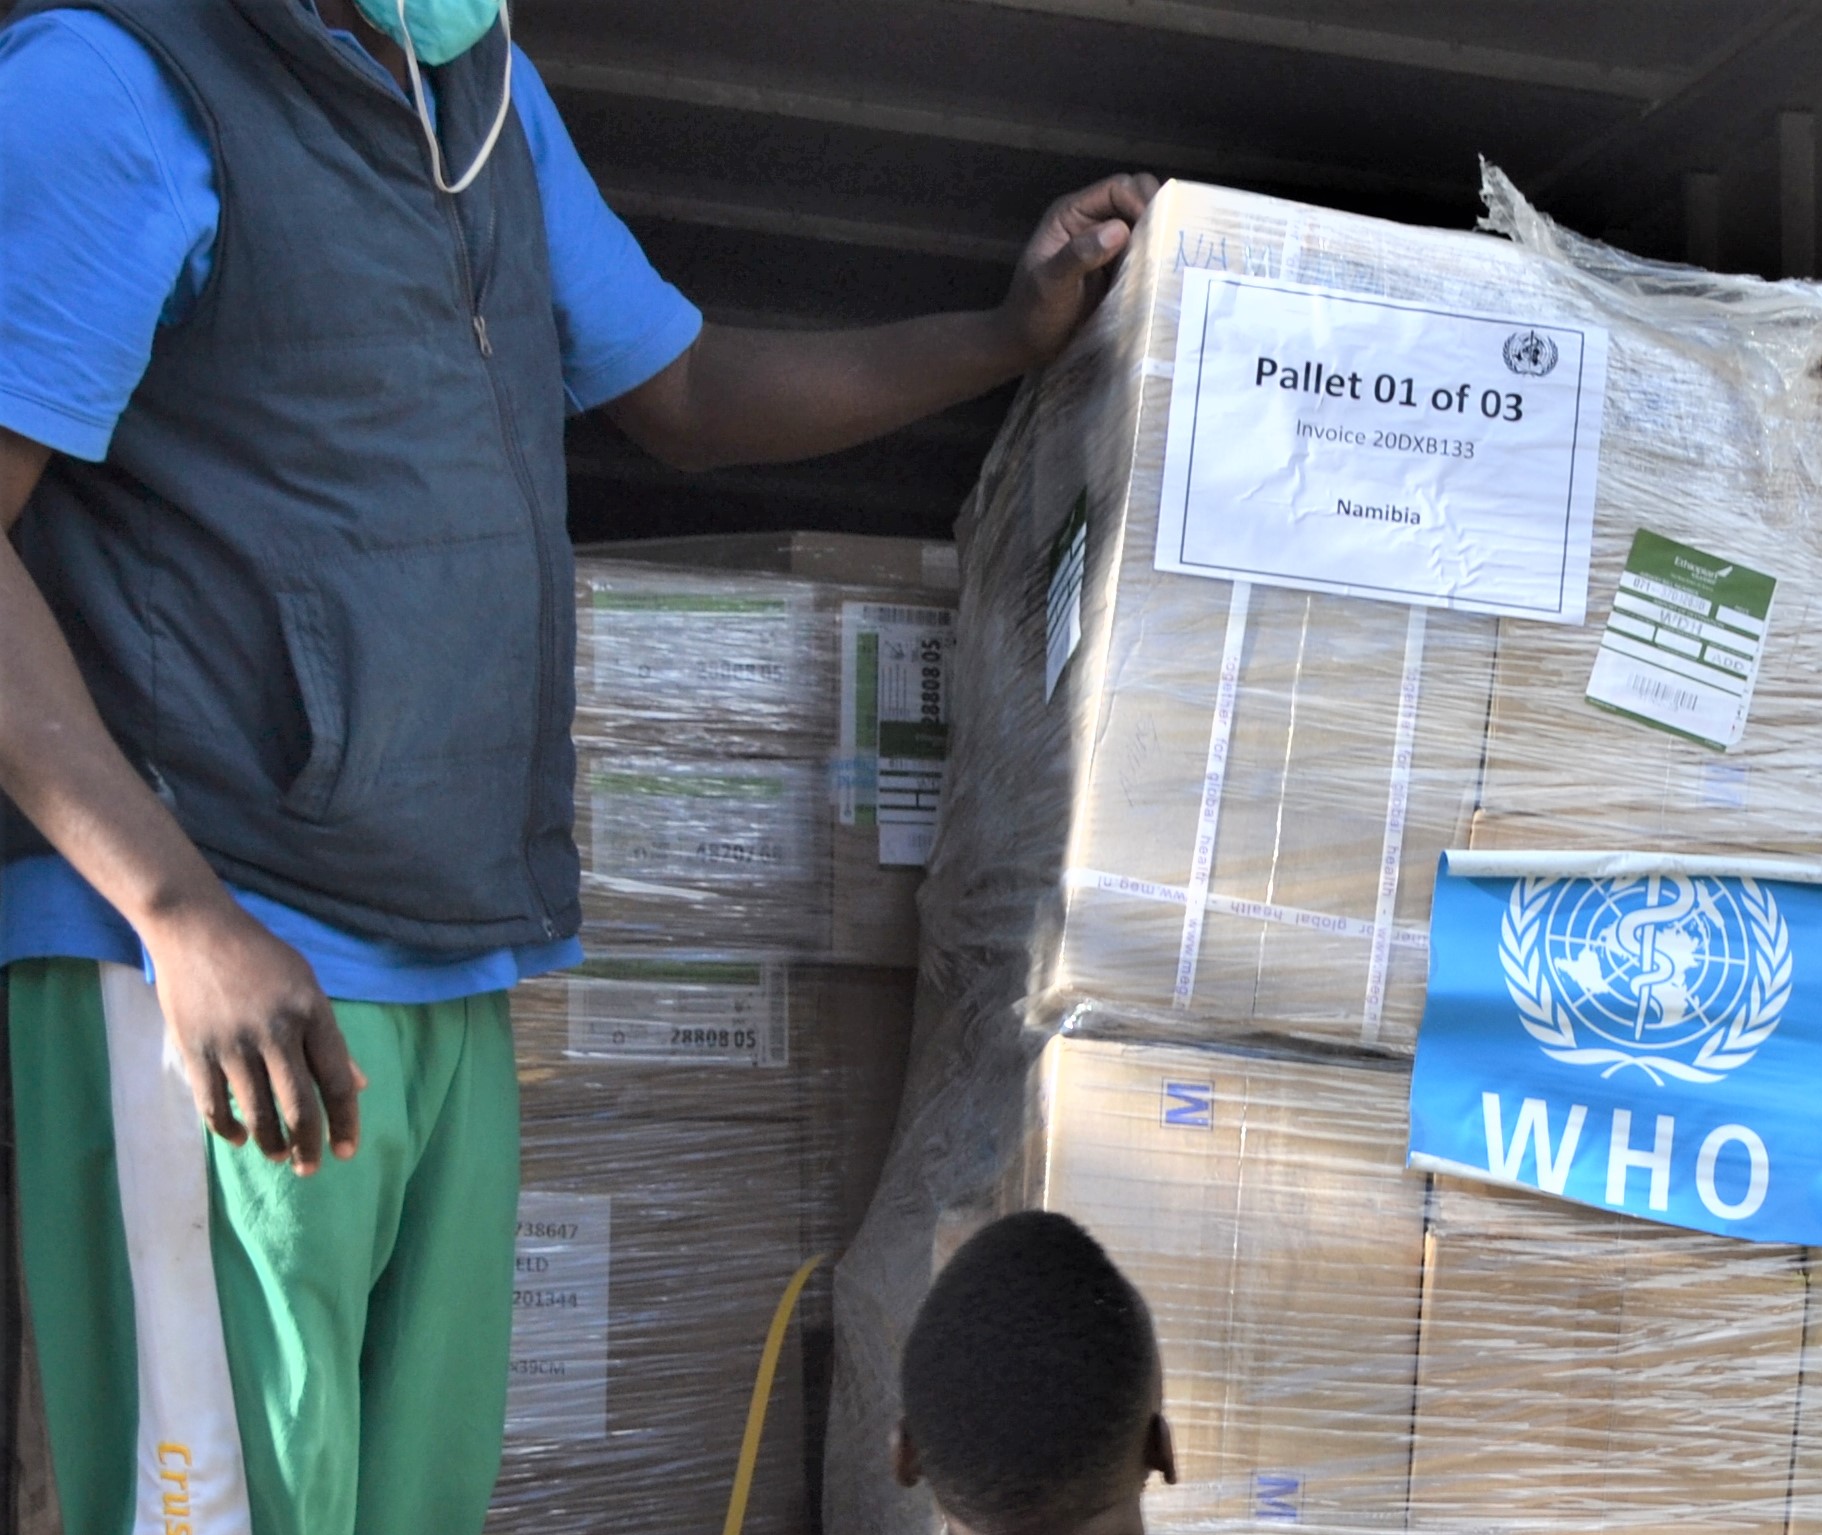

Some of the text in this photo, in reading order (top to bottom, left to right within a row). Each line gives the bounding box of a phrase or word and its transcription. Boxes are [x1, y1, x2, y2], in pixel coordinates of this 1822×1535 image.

[1256, 357, 1524, 422] Pallet 01 of 03
[1296, 419, 1475, 460] Invoice 20DXB133
[1336, 499, 1421, 525] Namibia
[921, 638, 940, 663] 05
[1212, 739, 1231, 763] for
[1202, 772, 1221, 824] global
[1388, 780, 1407, 836] global
[1195, 836, 1213, 884] health
[1383, 846, 1400, 898] health
[1095, 873, 1188, 903] ww.meg.nl
[1230, 900, 1284, 921] health
[1293, 910, 1348, 932] global
[734, 1030, 757, 1049] 05
[1482, 1092, 1769, 1220] WHO
[514, 1222, 579, 1239] 738647
[516, 1256, 549, 1273] ELD
[512, 1290, 578, 1308] 201344
